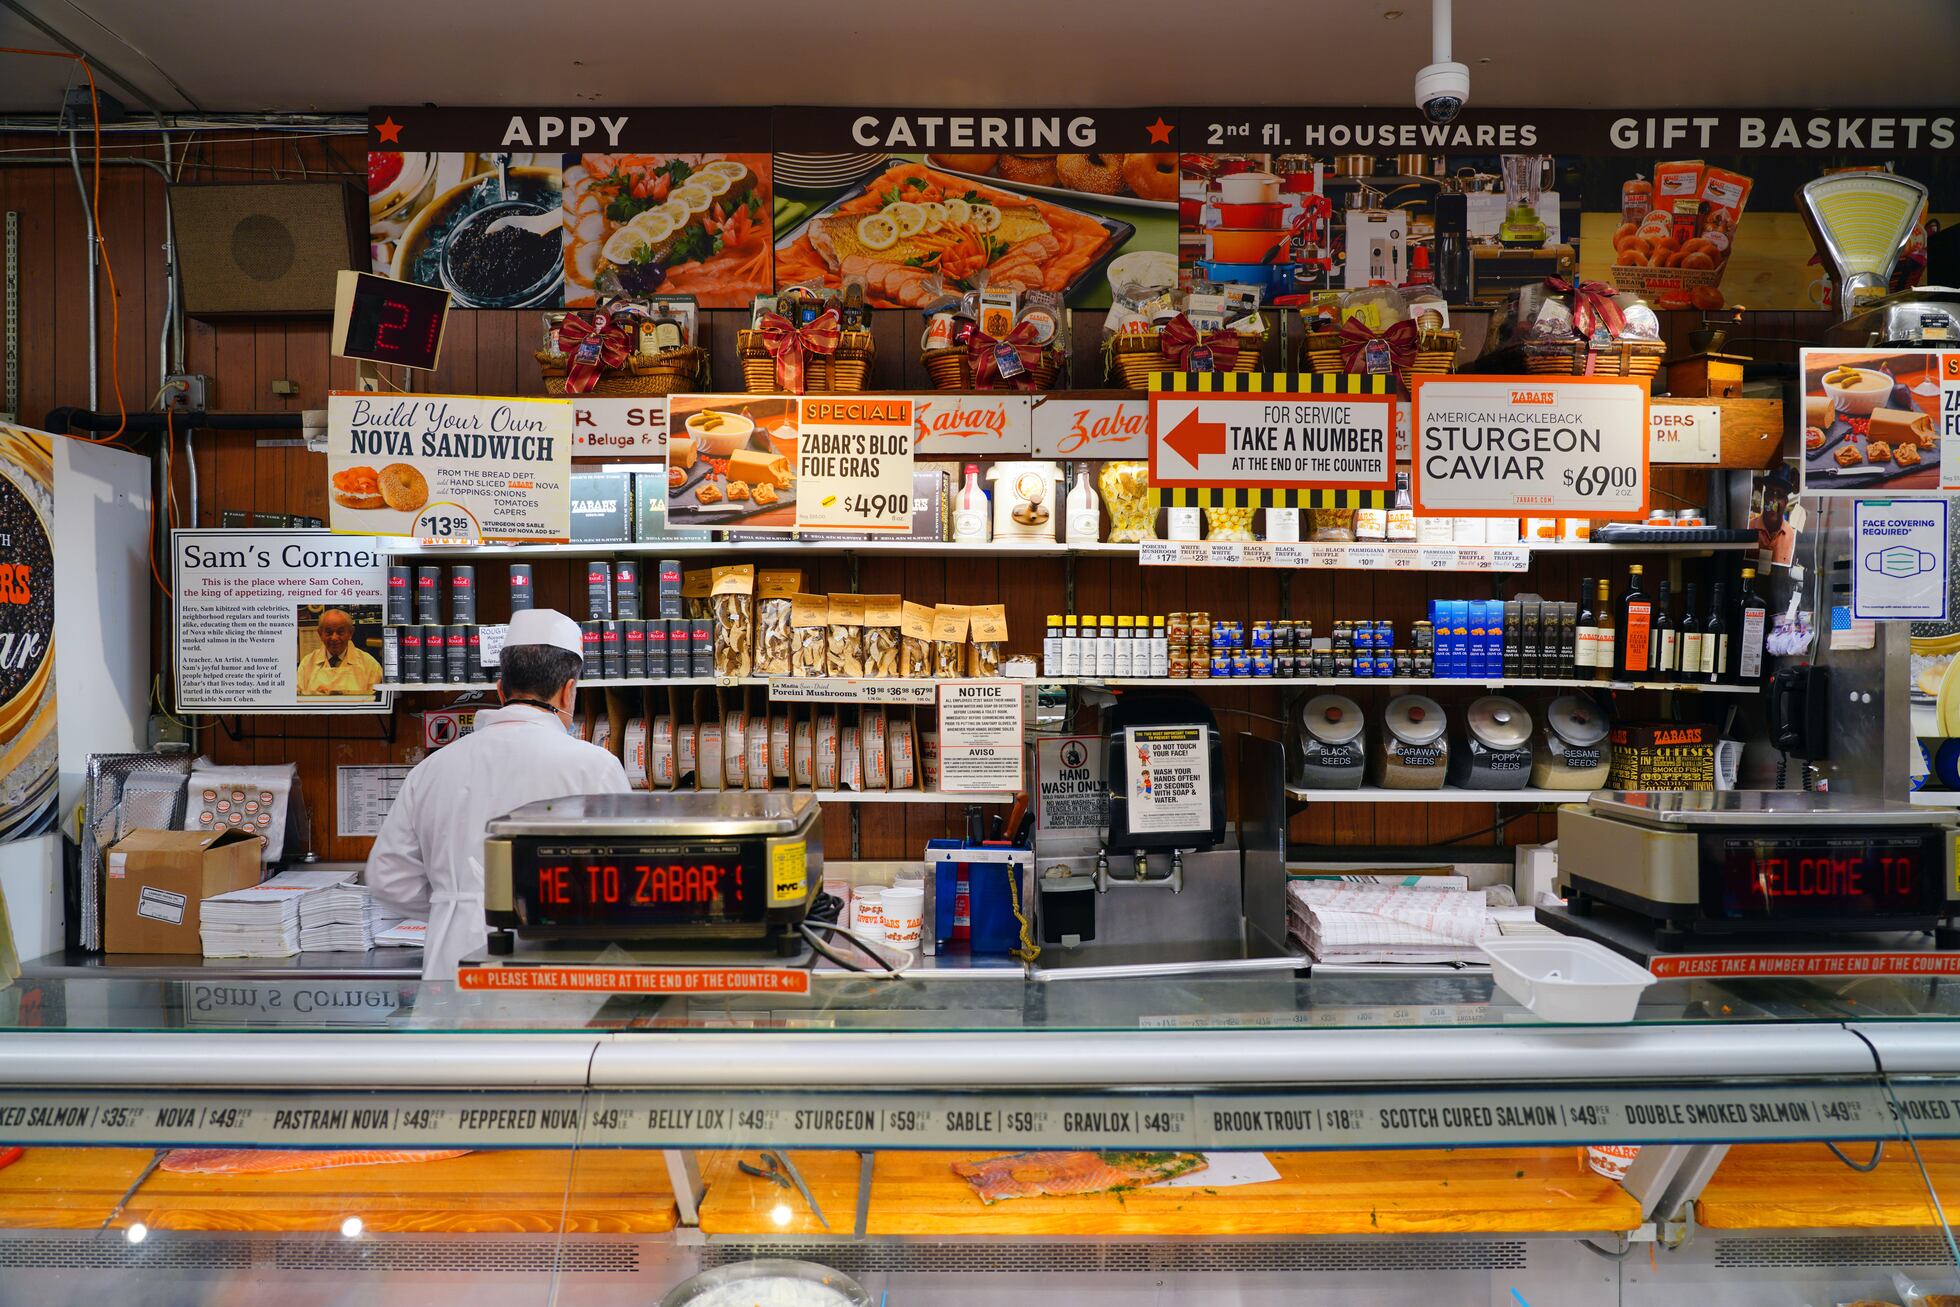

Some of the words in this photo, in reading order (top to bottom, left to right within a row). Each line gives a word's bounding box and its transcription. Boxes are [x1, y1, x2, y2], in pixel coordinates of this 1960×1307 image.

[501, 116, 628, 146] APPY
[852, 116, 1097, 147] CATERING
[1207, 123, 1250, 145] 2nd
[1262, 122, 1291, 146] fl.
[1305, 124, 1538, 147] HOUSEWARES
[1610, 117, 1719, 148] GIFT
[1740, 117, 1955, 148] BASKETS
[352, 400, 419, 427] Build
[425, 403, 483, 432] Your
[490, 406, 546, 432] Own
[808, 404, 907, 420] SPECIAL!
[1264, 406, 1290, 423] FOR
[1295, 406, 1351, 425] SERVICE
[1427, 412, 1496, 423] AMERICAN
[1499, 413, 1583, 424] HACKLEBACK
[588, 433, 634, 448] Beluga
[1230, 427, 1277, 450] TAKE
[1284, 428, 1296, 451] A
[1303, 428, 1383, 452] NUMBER
[1426, 427, 1601, 452] STURGEON
[1657, 430, 1680, 442] P.M.
[351, 430, 414, 455] NOVA
[422, 433, 554, 461] SANDWICH
[802, 434, 866, 454] ZABAR'S
[869, 435, 908, 455] BLOC
[802, 457, 837, 477] FOIE
[839, 458, 880, 478] GRAS
[1232, 457, 1245, 470] AT
[1248, 457, 1268, 471] THE
[1271, 458, 1291, 471] END
[1295, 458, 1308, 471] OF
[1311, 458, 1331, 472] THE
[1334, 459, 1381, 472] COUNTER
[1426, 456, 1544, 480] CAVIAR
[438, 469, 461, 477] FROM
[464, 470, 480, 478] THE
[482, 471, 510, 479] BREAD
[450, 479, 474, 487] HAND
[476, 480, 506, 488] SLICED
[536, 482, 559, 490] NOVA
[494, 499, 539, 507] TOMATOES
[494, 508, 527, 516] CAPERS
[1862, 520, 1886, 528] FACE
[1887, 520, 1935, 528] COVERING
[184, 544, 270, 568] Sam's
[202, 578, 221, 586] This
[224, 578, 232, 586] is
[234, 578, 249, 586] the
[252, 579, 275, 587] place
[278, 578, 306, 586] where
[309, 578, 329, 586] Sam
[184, 589, 199, 597] the
[201, 589, 221, 598] king
[224, 589, 234, 597] of
[288, 589, 322, 598] reigned
[325, 589, 338, 597] for
[341, 589, 352, 597] 46
[356, 590, 383, 598] years.
[806, 689, 857, 697] Mushrooms
[959, 687, 1001, 697] NOTICE
[1320, 748, 1349, 757] BLACK
[1322, 756, 1351, 765] SEEDS
[1397, 748, 1441, 757] CARAWAY
[1405, 756, 1435, 765] SEEDS
[1491, 753, 1521, 763] POPPY
[1565, 750, 1600, 759] SESAME
[1491, 762, 1520, 771] SEEDS
[1568, 758, 1598, 768] SEEDS
[1060, 769, 1090, 780] HAND
[1041, 782, 1074, 794] WASH
[539, 867, 569, 903] ME
[587, 866, 619, 903] TO
[1752, 858, 1863, 896] WELCOME
[1880, 857, 1911, 894] TO
[777, 883, 797, 891] NYC
[1678, 960, 1717, 973] PLEASE
[1721, 960, 1746, 973] TAKE
[1749, 960, 1756, 972] A
[1759, 959, 1804, 972] NUMBER
[1808, 959, 1821, 971] AT
[1825, 959, 1844, 971] THE
[1847, 958, 1867, 971] END
[1871, 958, 1885, 971] OF
[1890, 958, 1909, 970] THE
[488, 972, 528, 986] PLEASE
[531, 972, 557, 986] TAKE
[560, 973, 567, 986] A
[570, 973, 616, 987] NUMBER
[619, 973, 632, 987] AT
[635, 973, 657, 987] THE
[660, 974, 681, 987] END
[685, 974, 699, 987] OF
[702, 974, 724, 987] THE
[727, 974, 778, 988] COUNTER
[27, 1107, 89, 1127] SALMON
[101, 1108, 128, 1128] $35
[155, 1109, 195, 1129] NOVA
[209, 1110, 237, 1129] $49
[272, 1110, 347, 1130] PASTRAMI
[349, 1110, 389, 1130] NOVA
[403, 1110, 430, 1130] $49
[458, 1110, 537, 1130] PEPPERED
[539, 1110, 579, 1130] NOVA
[592, 1110, 619, 1130] $49
[648, 1110, 693, 1130] BELLY
[696, 1110, 723, 1130] LOX
[738, 1111, 765, 1130] $49
[794, 1111, 875, 1131] STURGEON
[890, 1112, 916, 1131] $59
[1213, 1112, 1263, 1132] BROOK
[1265, 1110, 1312, 1131] TROUT
[1326, 1110, 1351, 1130] $18
[1380, 1108, 1439, 1129] SCOTCH
[1442, 1107, 1493, 1128] CURED
[1496, 1105, 1557, 1127] SALMON
[1571, 1105, 1597, 1126] $49
[1625, 1105, 1685, 1125] DOUBLE
[1686, 1103, 1748, 1124] SMOKED
[1751, 1102, 1809, 1123] SALMON
[1822, 1101, 1849, 1122] $49
[946, 1112, 993, 1132] SABLE
[1006, 1112, 1034, 1132] $59
[1063, 1112, 1131, 1133] GRAVLOX
[1144, 1112, 1171, 1133] $49
